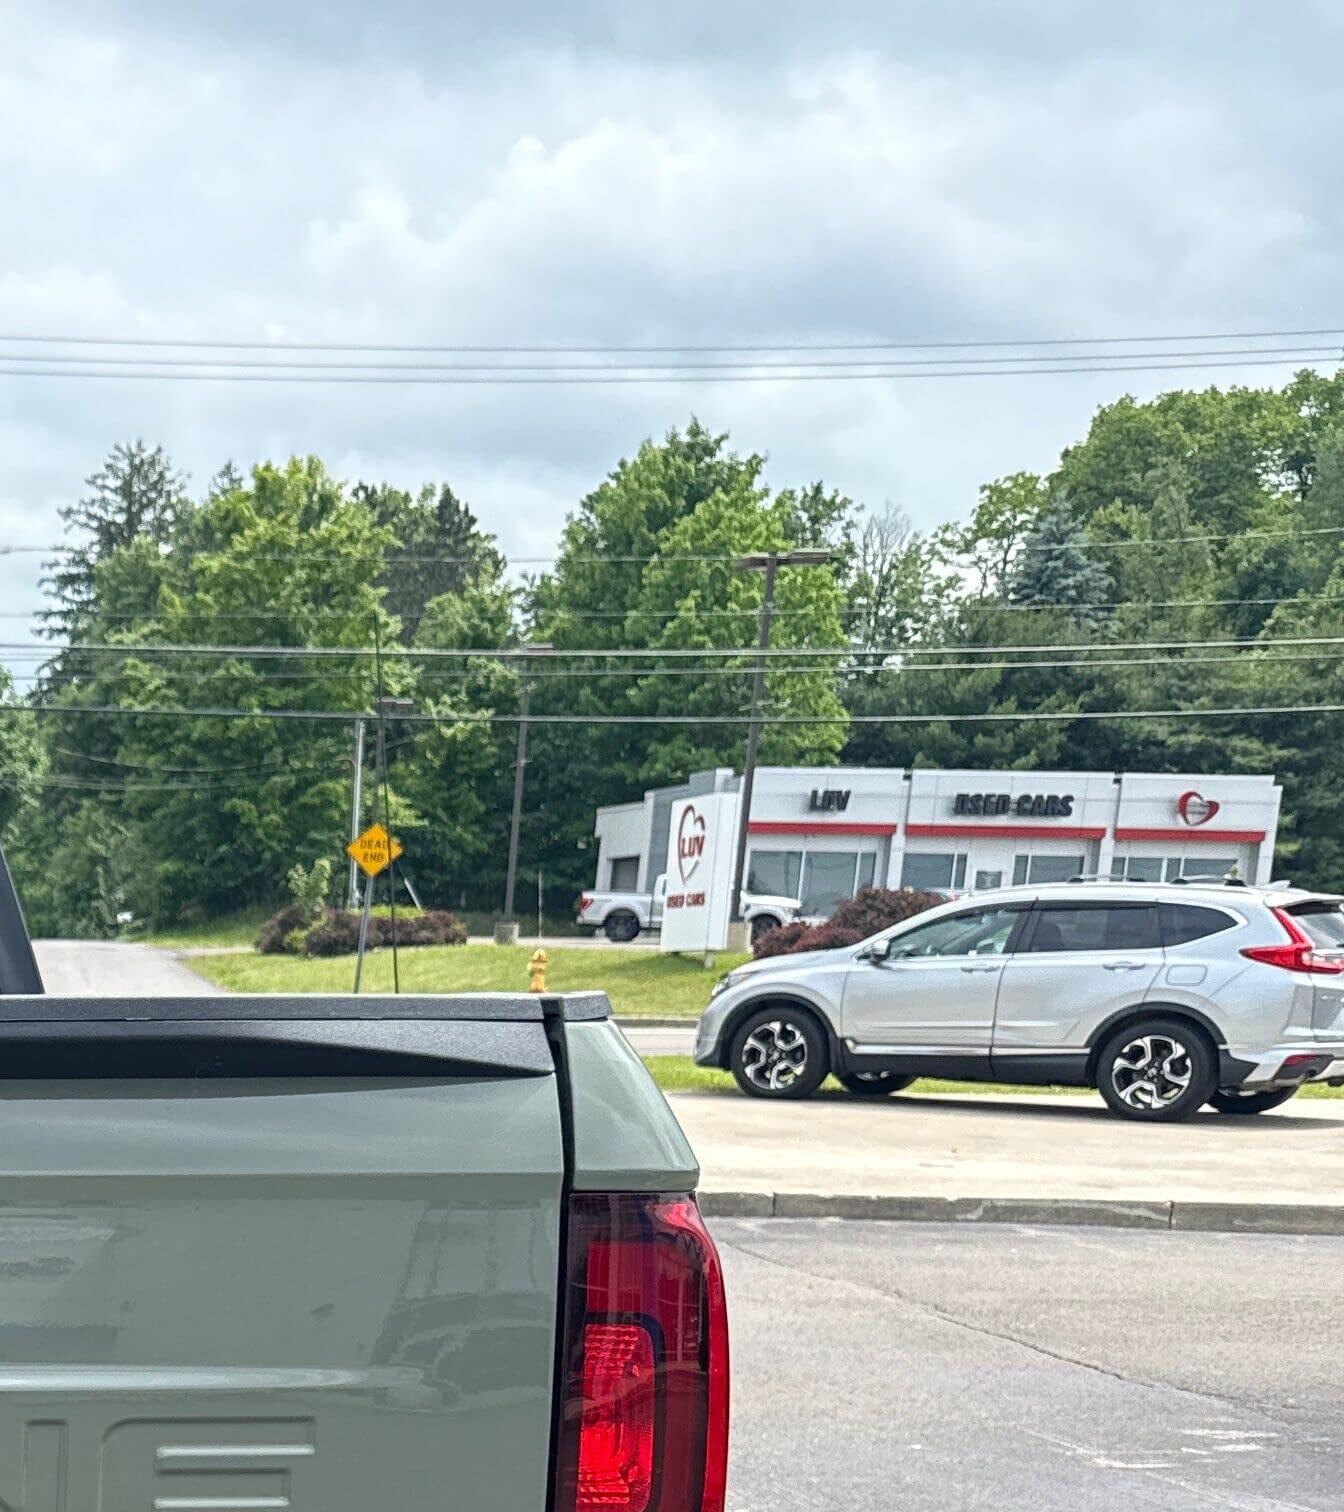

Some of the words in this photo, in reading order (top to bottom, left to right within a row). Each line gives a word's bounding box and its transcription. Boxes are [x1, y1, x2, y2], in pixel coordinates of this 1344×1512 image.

[1016, 794, 1075, 817] CARS
[362, 851, 385, 862] END
[680, 835, 706, 859] LUV
